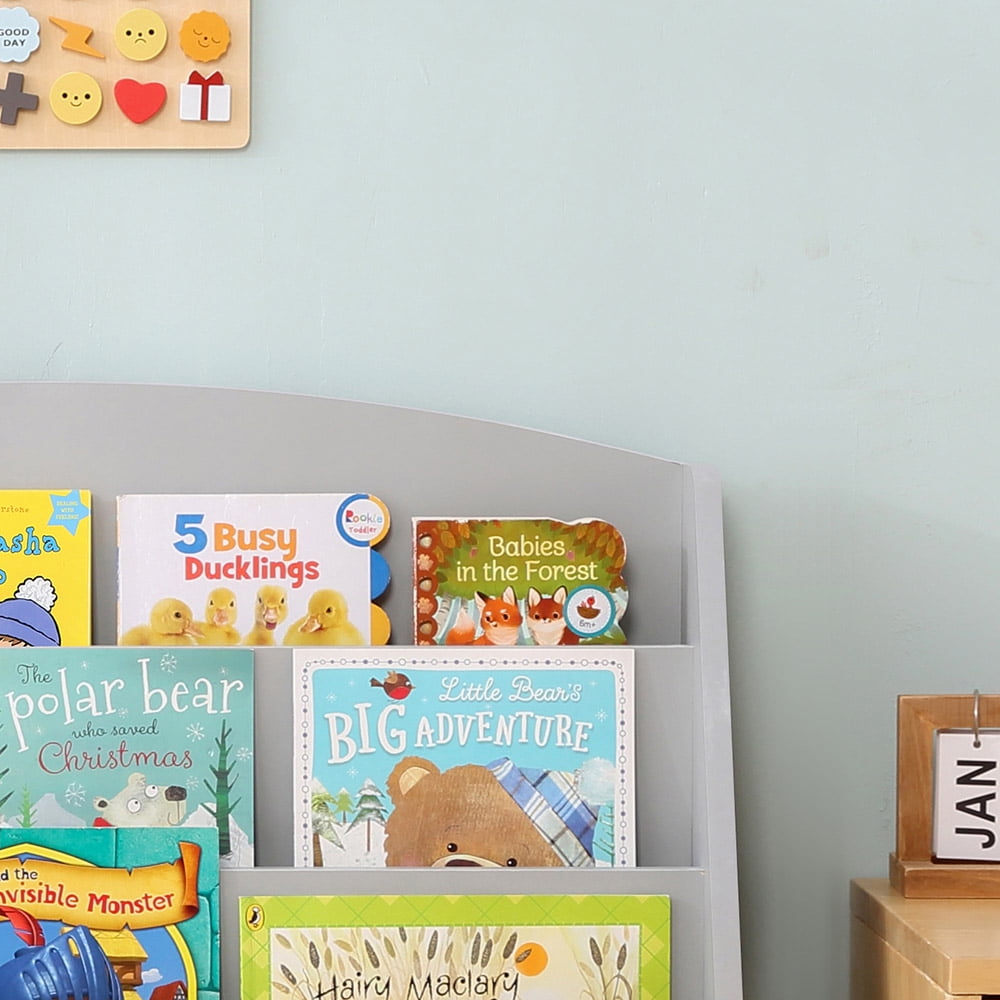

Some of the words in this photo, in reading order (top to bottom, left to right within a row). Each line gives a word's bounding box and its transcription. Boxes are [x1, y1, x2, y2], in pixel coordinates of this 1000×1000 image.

[3, 38, 27, 47] DAY
[345, 510, 383, 524] Rookie
[173, 514, 208, 554] 5
[213, 523, 298, 561] Busy
[488, 534, 566, 557] Babies
[184, 556, 320, 588] Ducklings
[456, 561, 477, 582] in
[483, 560, 518, 582] the
[525, 560, 598, 581] Forest
[17, 663, 53, 685] The
[438, 676, 503, 703] Little
[508, 676, 582, 703] Bear's
[5, 667, 124, 753] polar
[138, 658, 243, 715] bear
[72, 723, 106, 740] who
[110, 720, 159, 738] saved
[324, 700, 407, 766] BIG
[415, 711, 594, 753] ADVENTURE
[38, 740, 194, 775] Christmas
[955, 760, 998, 849] JAN
[14, 867, 39, 881] the
[87, 891, 175, 914] Monster
